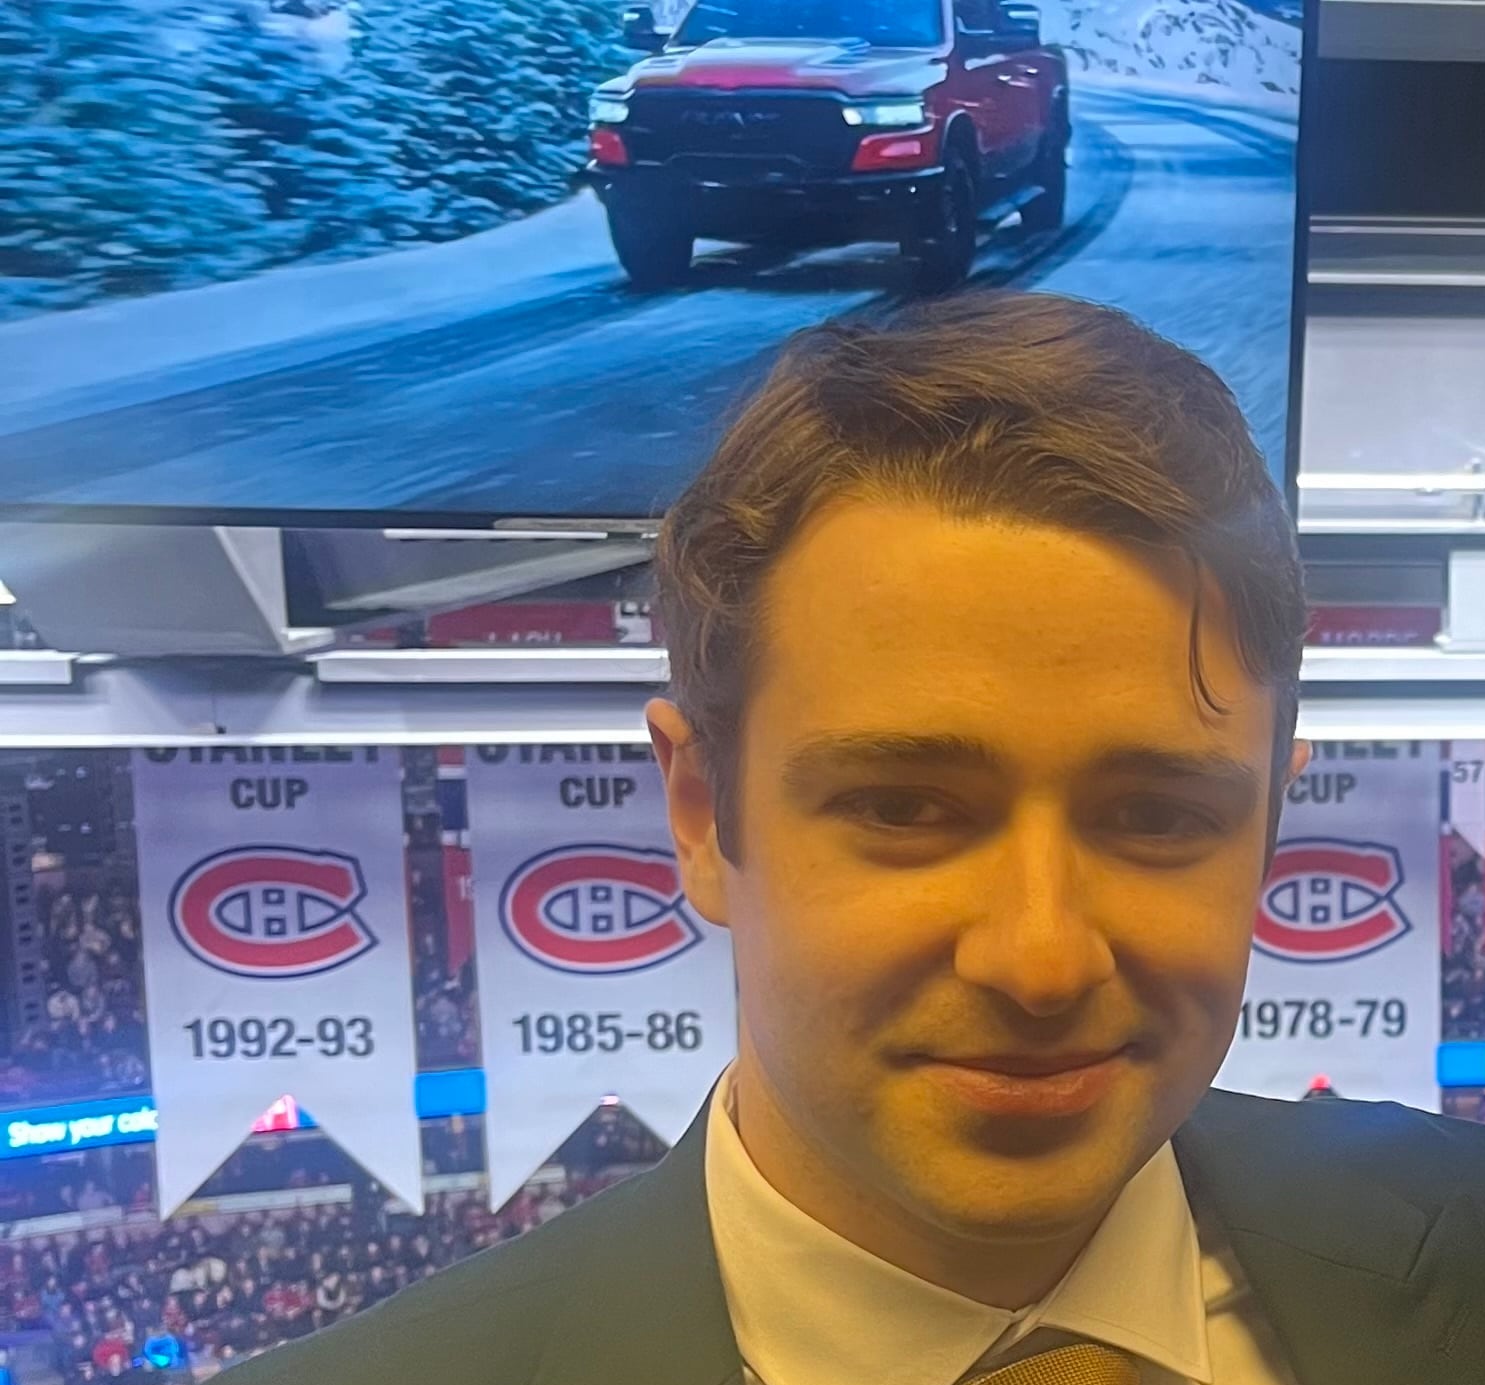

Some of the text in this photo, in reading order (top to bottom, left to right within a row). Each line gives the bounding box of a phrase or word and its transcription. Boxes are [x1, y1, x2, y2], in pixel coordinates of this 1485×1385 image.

[230, 777, 309, 810] CUP
[559, 776, 636, 808] CUP
[1287, 773, 1356, 804] CUP
[184, 1017, 375, 1058] 1992-93
[512, 1011, 703, 1053] 1985-86
[1241, 1000, 1407, 1040] 1978-79
